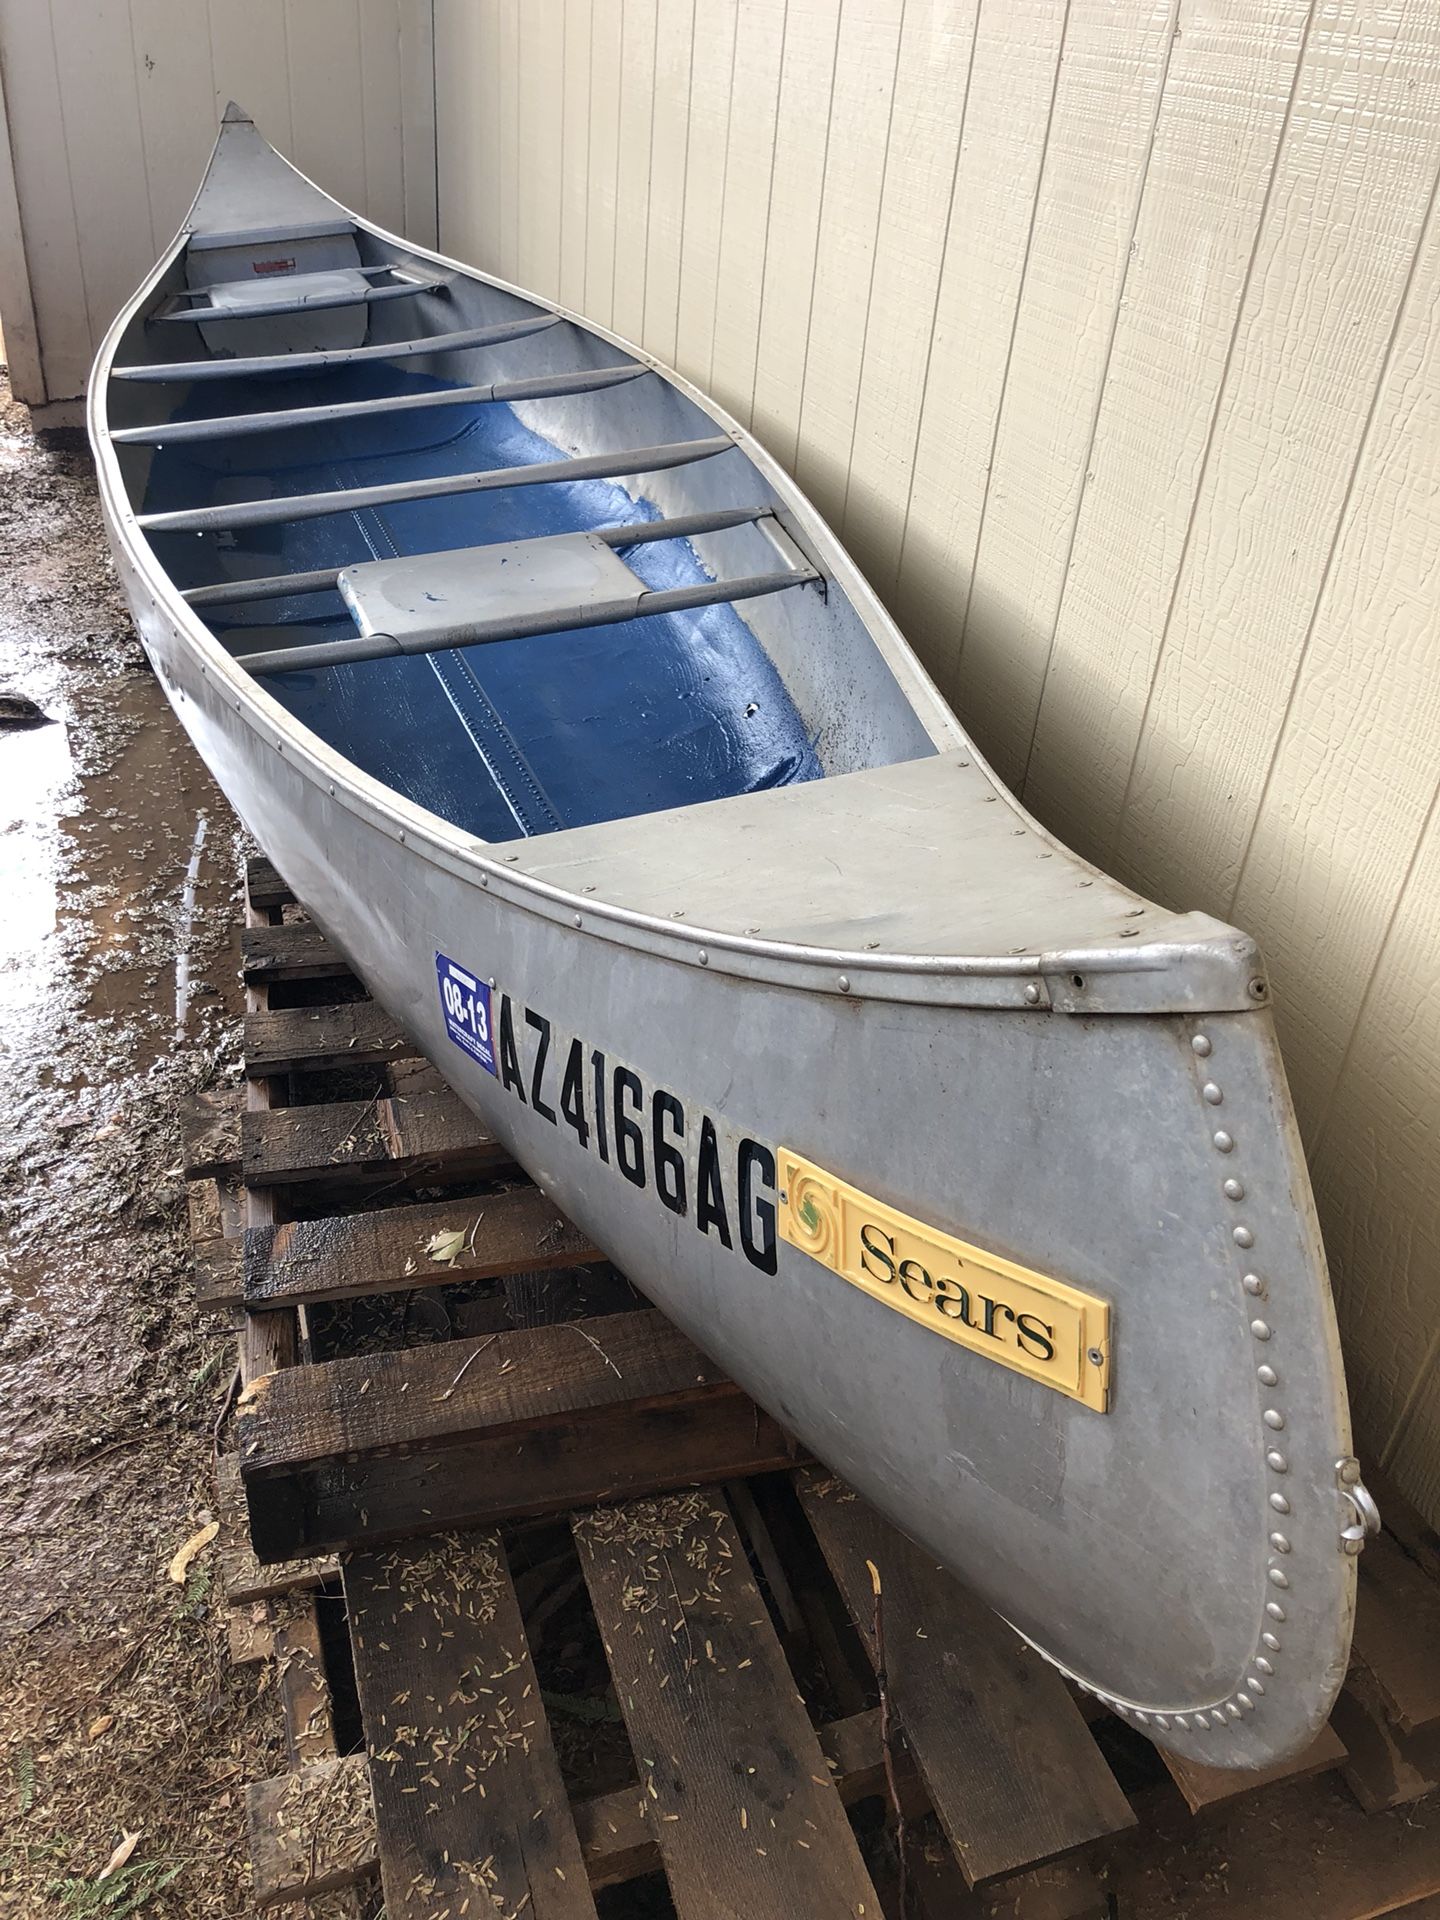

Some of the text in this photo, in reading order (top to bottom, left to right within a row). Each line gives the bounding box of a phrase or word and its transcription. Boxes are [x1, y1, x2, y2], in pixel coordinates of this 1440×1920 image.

[443, 977, 488, 1041] 08-13
[500, 993, 778, 1277] AZ4166AG
[860, 1224, 1054, 1361] Sears
